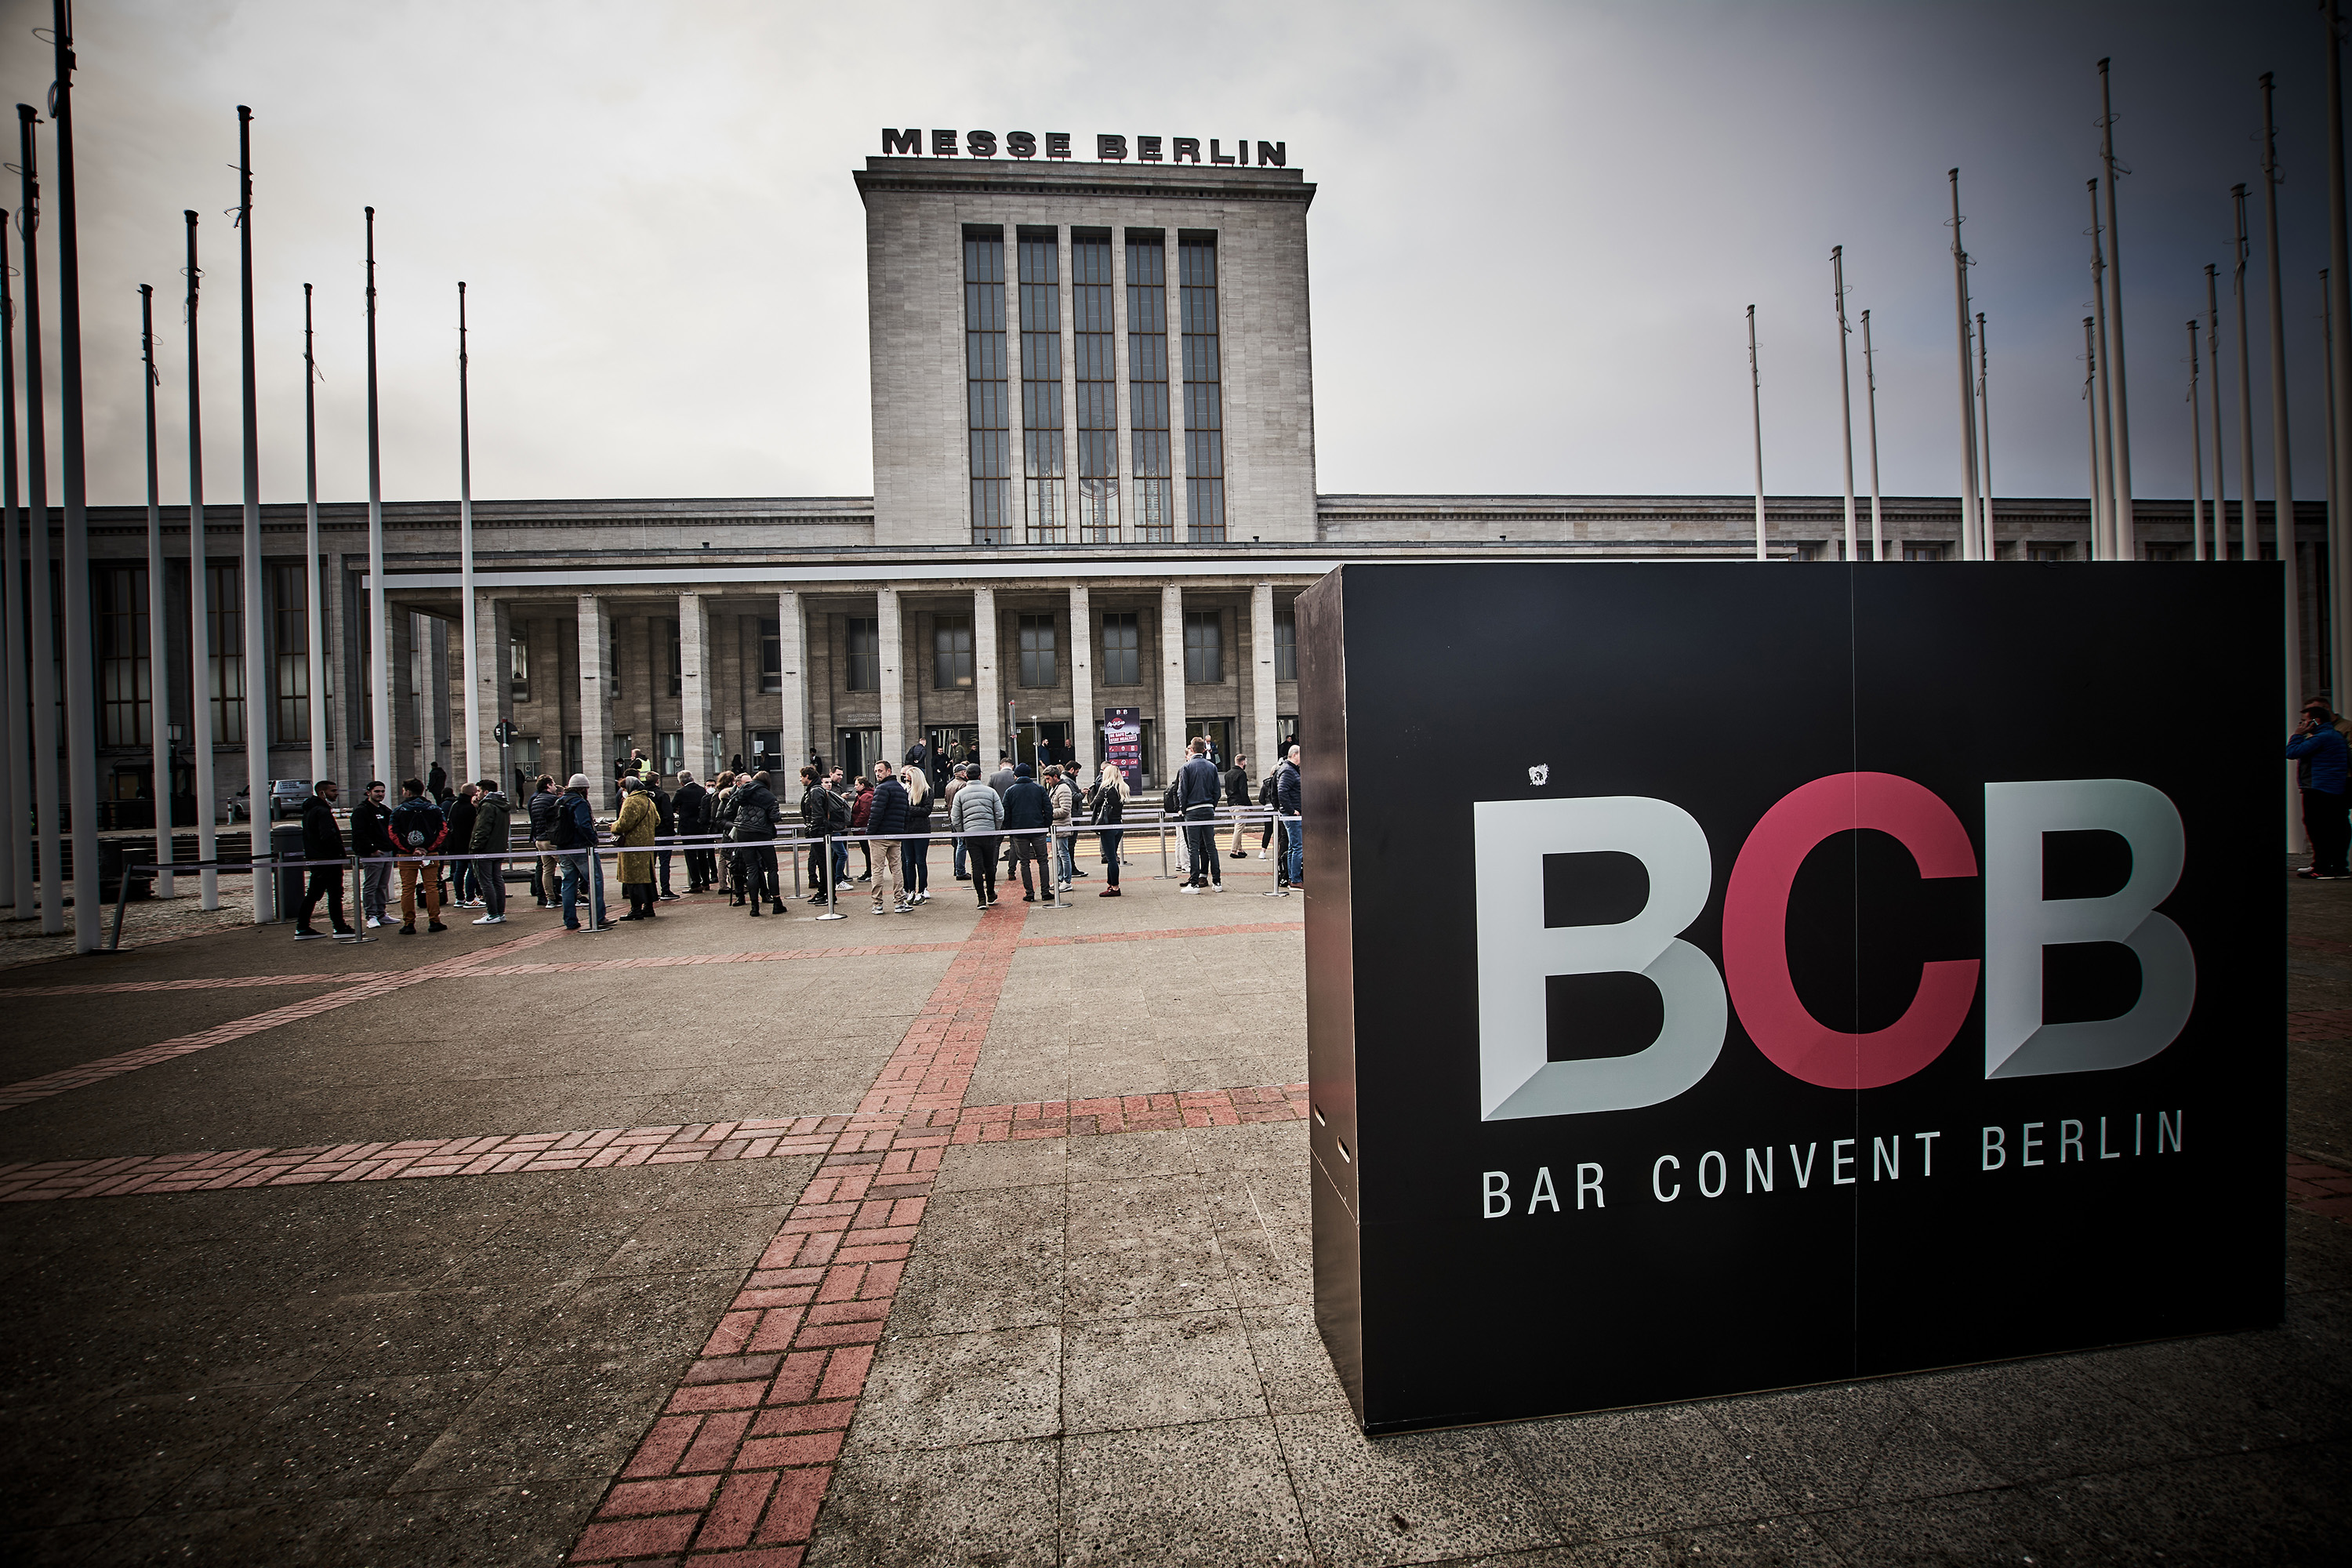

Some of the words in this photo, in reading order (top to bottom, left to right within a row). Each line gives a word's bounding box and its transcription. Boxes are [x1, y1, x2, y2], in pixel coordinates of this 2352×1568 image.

[882, 128, 1072, 158] MESSE
[1097, 133, 1286, 166] BERLIN
[1474, 771, 2198, 1122] BCB
[1483, 1162, 1606, 1219] BAR
[1652, 1131, 1941, 1203] CONVENT
[1982, 1109, 2183, 1171] BERLIN
